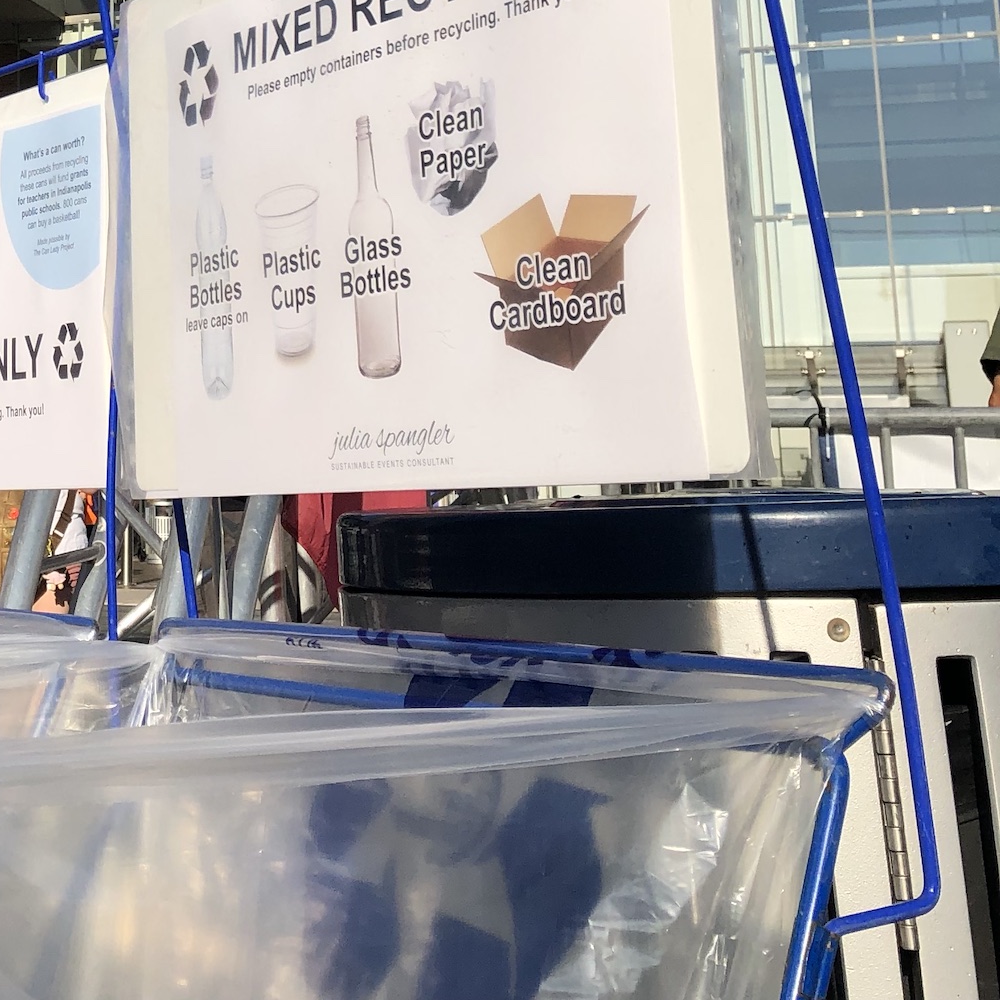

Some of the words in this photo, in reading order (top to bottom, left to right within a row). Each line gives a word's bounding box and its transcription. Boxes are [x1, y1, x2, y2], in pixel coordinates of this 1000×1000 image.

[248, 79, 281, 100] Please
[284, 65, 316, 88] empty
[320, 46, 382, 76] containers
[386, 31, 430, 56] before
[434, 10, 500, 42] recycling.
[419, 106, 482, 140] Clean
[23, 148, 44, 161] What's
[50, 144, 62, 154] can
[63, 136, 85, 150] worth?
[420, 143, 486, 178] Paper
[20, 183, 34, 192] these
[35, 179, 48, 189] cans
[48, 176, 57, 185] will
[70, 169, 88, 182] grants
[28, 164, 52, 179] proceeds
[52, 162, 64, 172] from
[64, 155, 88, 170] recycling
[17, 197, 26, 206] for
[26, 191, 50, 204] teachers
[50, 189, 56, 197] in
[56, 181, 92, 197] Indianapolis
[22, 206, 38, 220] public
[40, 201, 62, 214] schools.
[74, 196, 88, 206] cans
[27, 221, 37, 230] can
[38, 217, 47, 228] buy
[52, 210, 81, 224] basketball!
[64, 234, 70, 242] by
[344, 235, 402, 264] Glass
[190, 245, 239, 277] Plastic
[262, 244, 322, 278] Plastic
[516, 253, 590, 286] Clean
[190, 278, 242, 309] Bottles
[340, 265, 411, 298] Bottles
[271, 284, 316, 313] Cups
[490, 284, 626, 331] Cardboard
[186, 317, 208, 333] leave
[210, 312, 233, 328] caps
[236, 310, 248, 324] on
[6, 404, 27, 418] Thank
[28, 403, 44, 418] you!
[328, 426, 373, 460] julia
[376, 420, 455, 456] spangler
[331, 461, 374, 471] SUSTAINABLE
[378, 460, 404, 469] EVENTS
[406, 457, 454, 467] CONSULTANT
